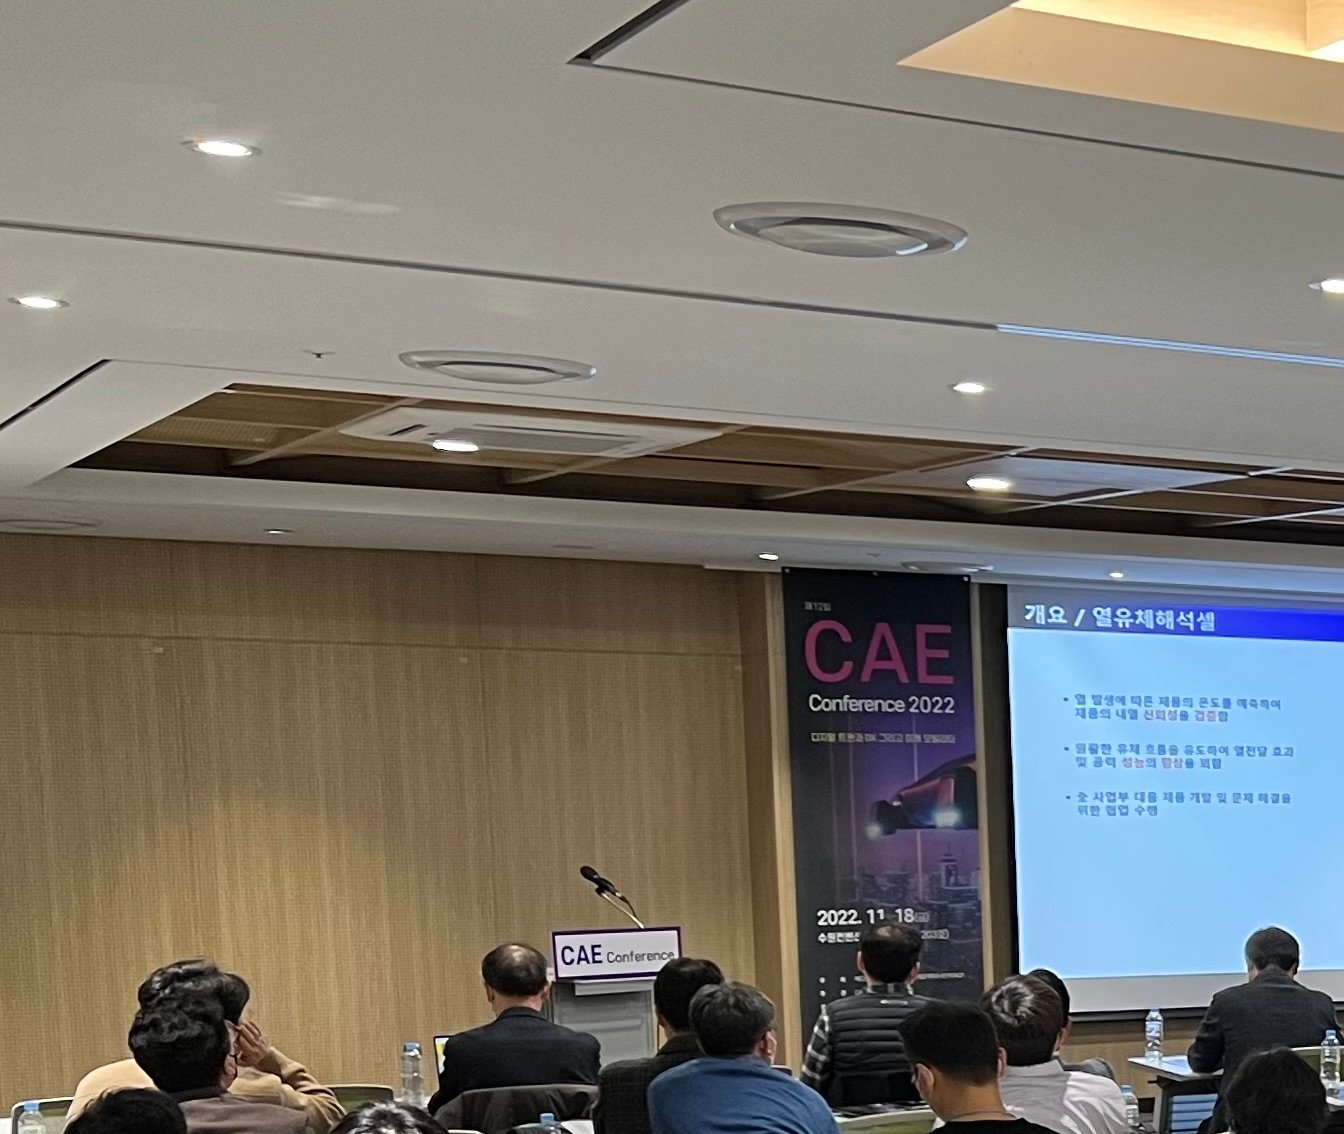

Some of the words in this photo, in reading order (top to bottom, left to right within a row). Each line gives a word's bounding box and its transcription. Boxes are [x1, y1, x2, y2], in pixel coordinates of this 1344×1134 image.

[1024, 604, 1068, 626] 개요
[1074, 608, 1086, 628] /
[1092, 606, 1216, 632] 열유체해석셀
[804, 619, 955, 685] CAE
[808, 693, 906, 713] Conference
[908, 695, 956, 714] 2022
[816, 909, 863, 926] 2022.
[560, 944, 604, 966] CAE
[606, 950, 675, 964] Conference
